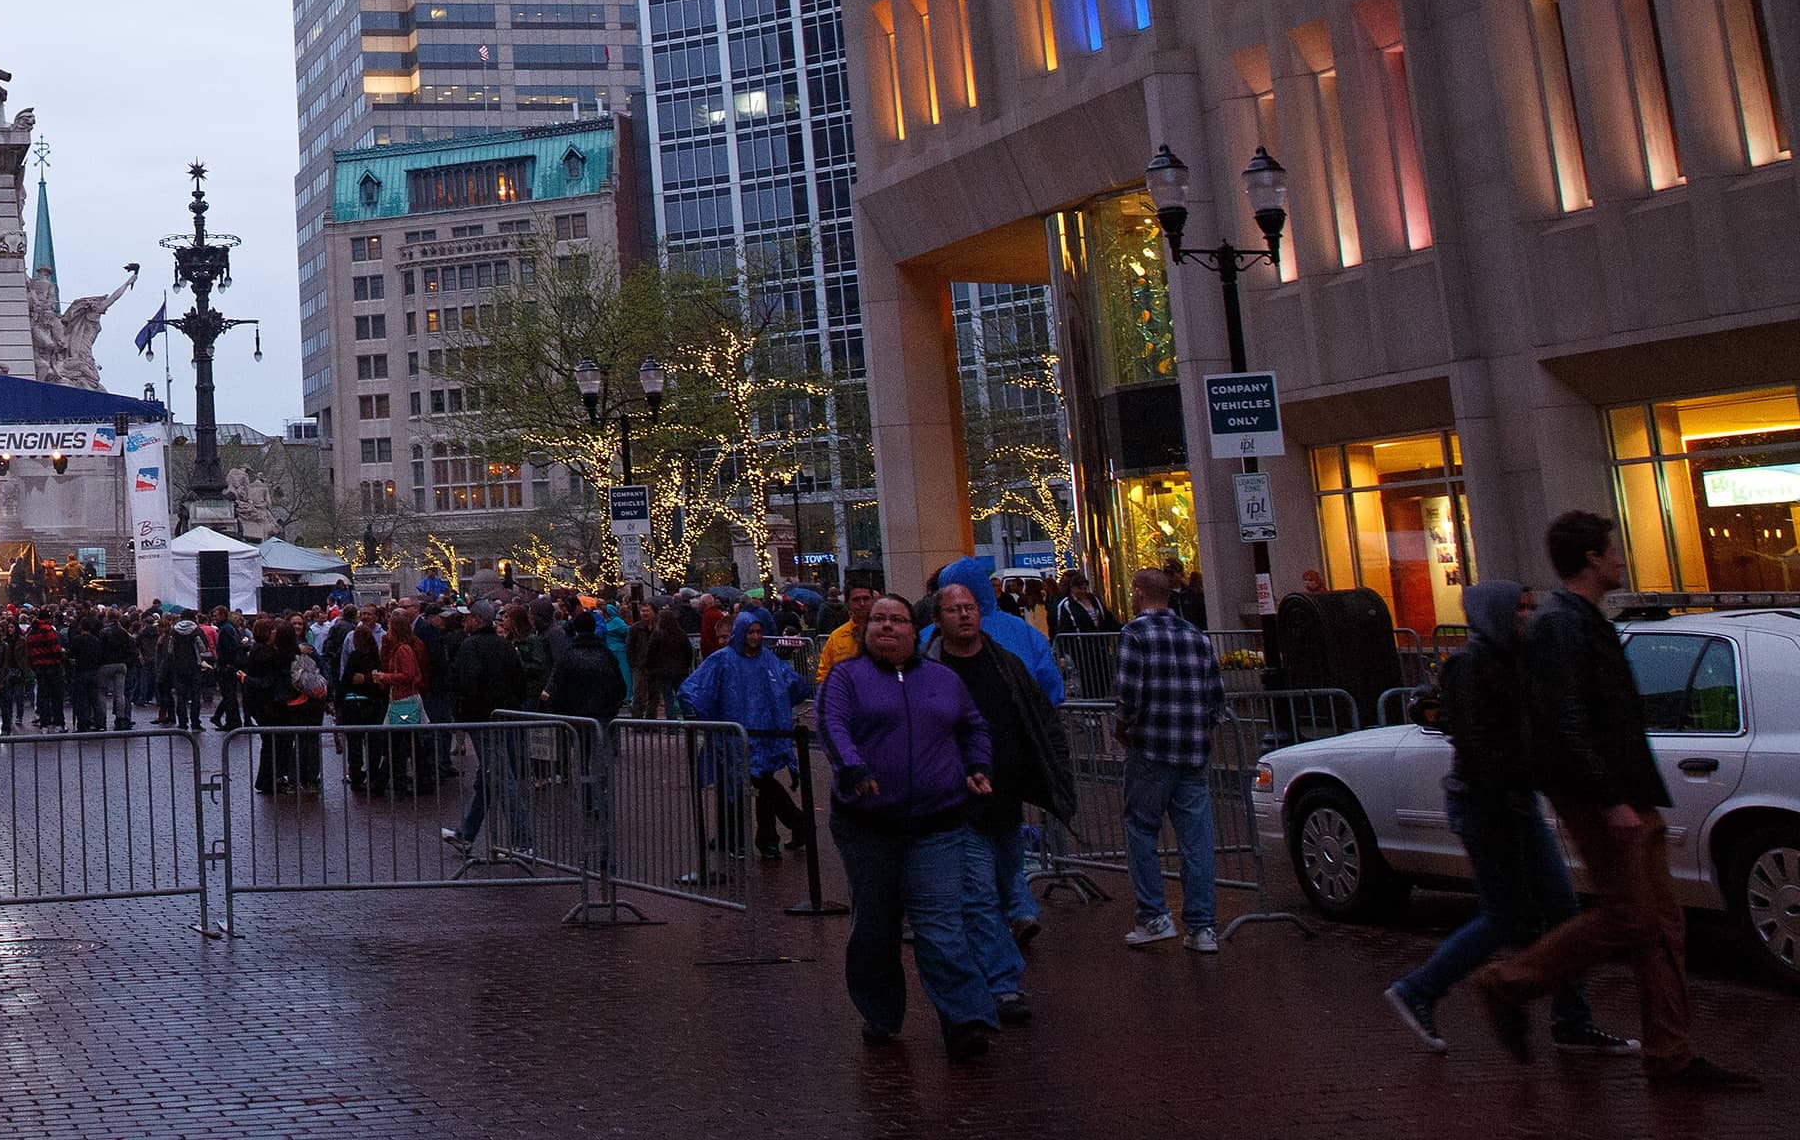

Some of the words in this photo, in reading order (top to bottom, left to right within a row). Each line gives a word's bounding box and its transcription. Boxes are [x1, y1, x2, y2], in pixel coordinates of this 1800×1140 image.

[1211, 382, 1268, 395] COMPANY
[1212, 398, 1272, 411] VEHICLES
[1227, 416, 1259, 427] ONLY
[1023, 556, 1053, 565] CHASE
